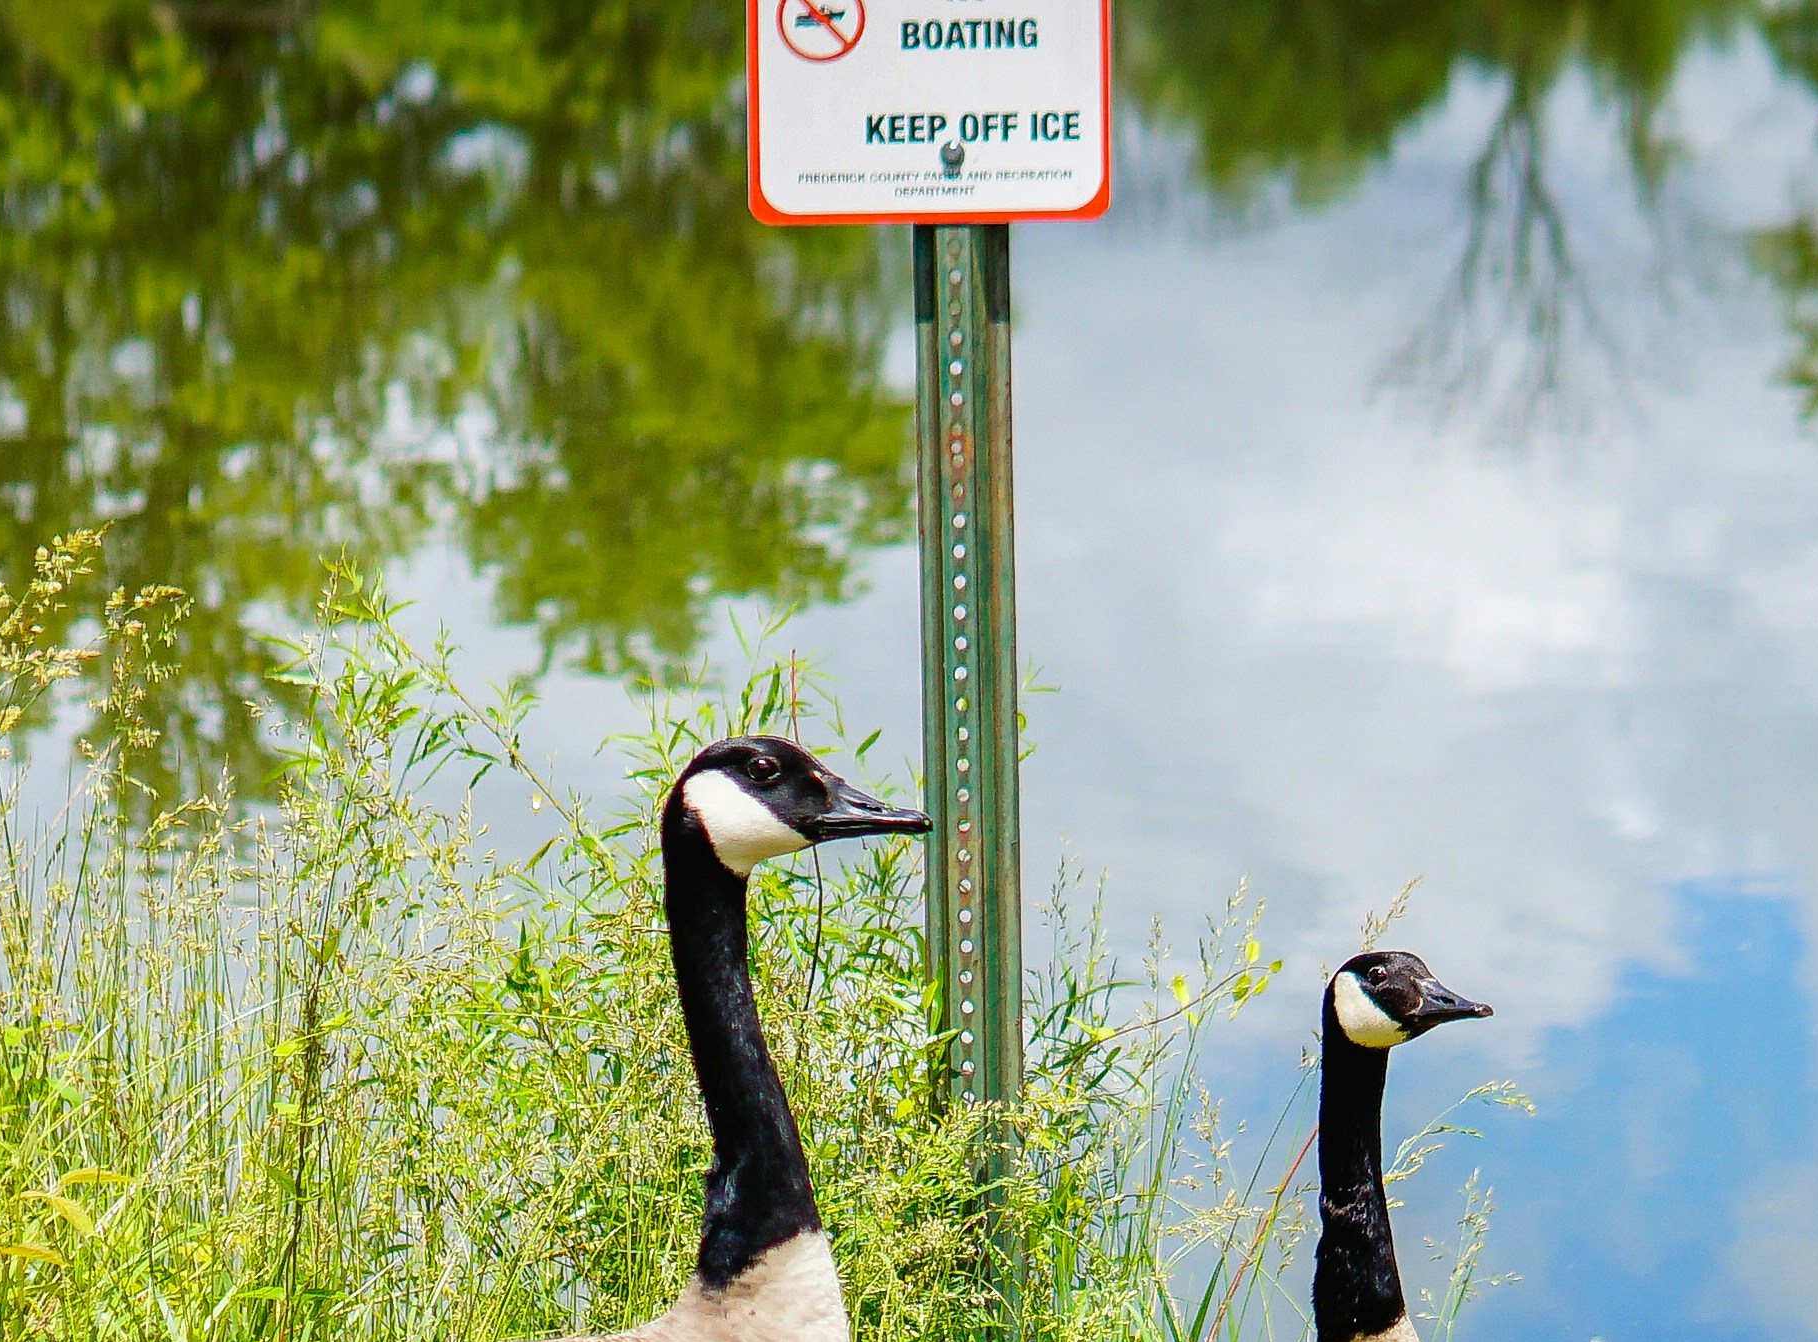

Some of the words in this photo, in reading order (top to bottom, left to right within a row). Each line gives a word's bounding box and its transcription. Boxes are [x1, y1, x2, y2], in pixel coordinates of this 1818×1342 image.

[901, 19, 1038, 50] BOATING
[865, 113, 947, 144] KEEP
[959, 112, 1019, 142] OFF
[1030, 111, 1081, 141] ICE
[798, 172, 866, 184] FREDERICK
[870, 171, 919, 183] COUNTY
[924, 170, 963, 181] PAR
[966, 170, 992, 181] AND
[995, 169, 1073, 180] RECREATION
[894, 186, 975, 198] DEPARTMENT
